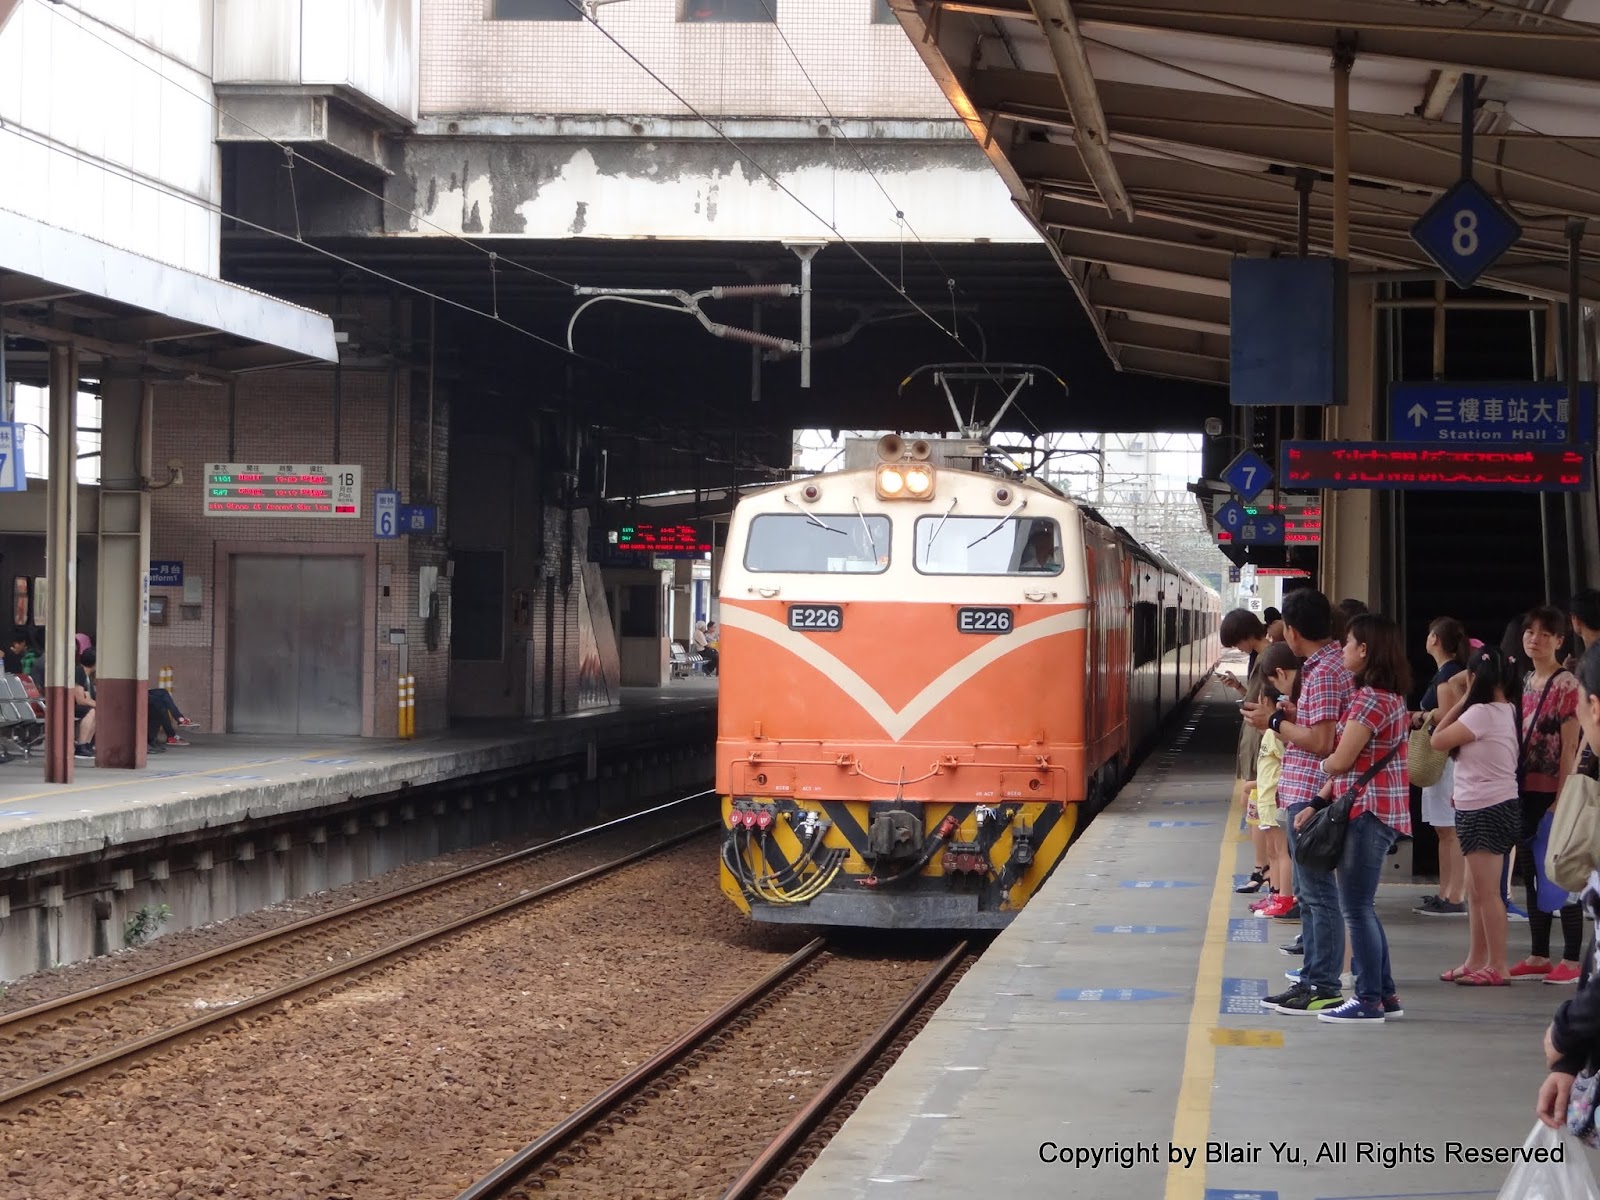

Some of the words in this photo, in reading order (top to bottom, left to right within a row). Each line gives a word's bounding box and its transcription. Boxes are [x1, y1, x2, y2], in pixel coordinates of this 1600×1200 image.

[1452, 209, 1478, 256] 8
[1438, 429, 1502, 440] Station
[1512, 429, 1547, 440] Hall
[338, 473, 354, 486] 1B
[1242, 466, 1256, 490] 7
[381, 511, 391, 535] 6
[1227, 508, 1237, 525] 6
[791, 609, 839, 627] E226
[960, 611, 1009, 629] E226
